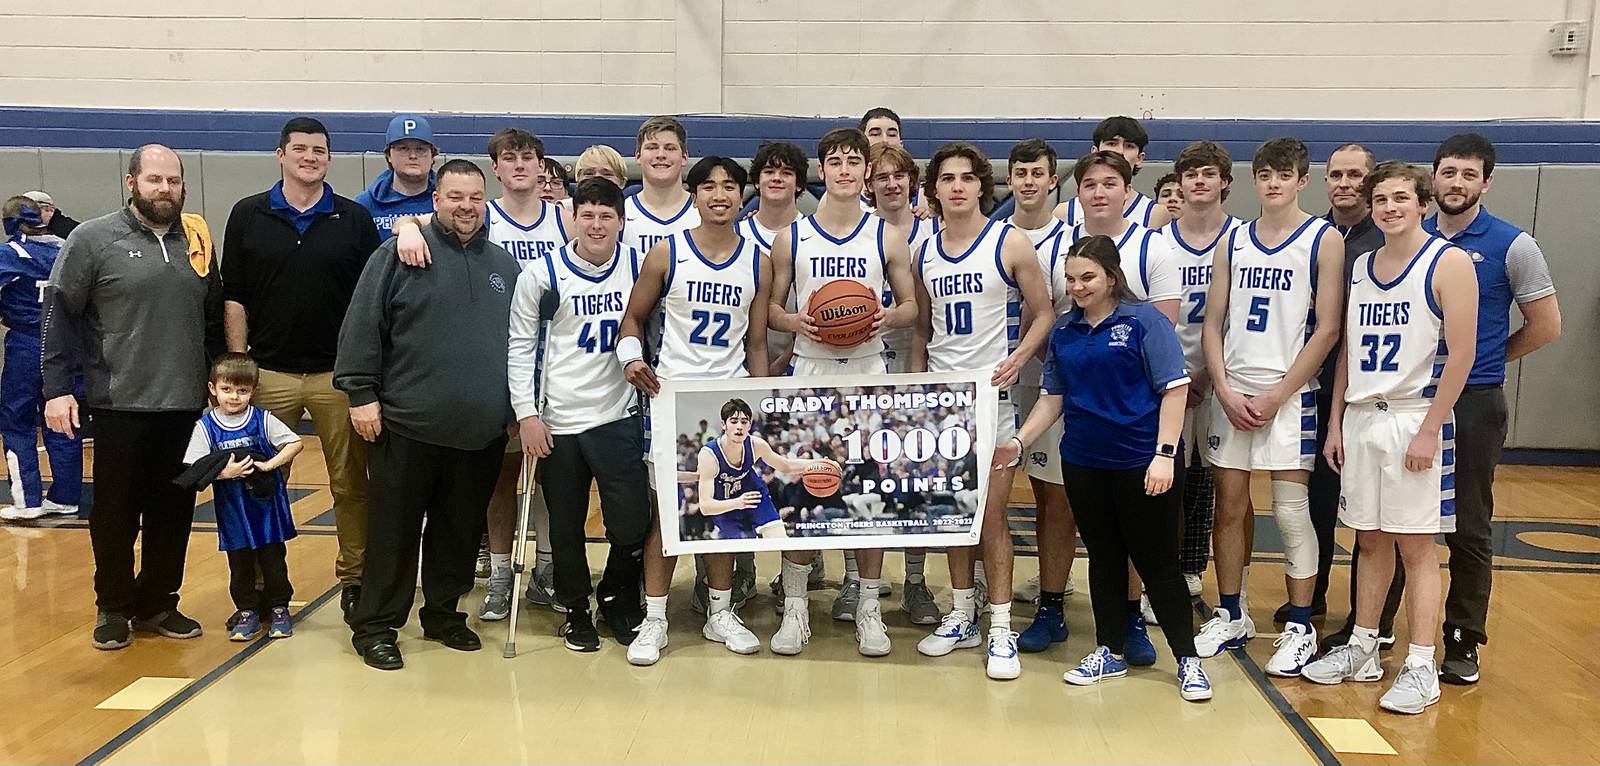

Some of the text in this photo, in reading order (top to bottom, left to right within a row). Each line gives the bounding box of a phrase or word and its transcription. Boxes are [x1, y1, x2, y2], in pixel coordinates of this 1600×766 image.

[404, 119, 417, 135] P
[810, 256, 867, 278] TIGERS
[1178, 265, 1213, 286] IGER
[1239, 267, 1294, 291] TIGERS
[686, 280, 743, 307] TIGERS
[931, 272, 984, 299] TIGERS
[571, 291, 623, 316] TIGERS
[820, 302, 868, 321] Wilson
[1246, 296, 1270, 333] 5
[1359, 301, 1410, 326] TIGERS
[689, 310, 731, 347] 22
[944, 300, 973, 335] 10
[577, 319, 618, 353] 40
[1360, 333, 1402, 371] 32
[760, 391, 972, 413] GRADY THOMPSON
[842, 427, 971, 464] 1000
[863, 476, 964, 493] POINTS
[795, 521, 844, 530] PRINCETON
[845, 520, 874, 529] TIGERS
[876, 519, 929, 528] BASKETBALL
